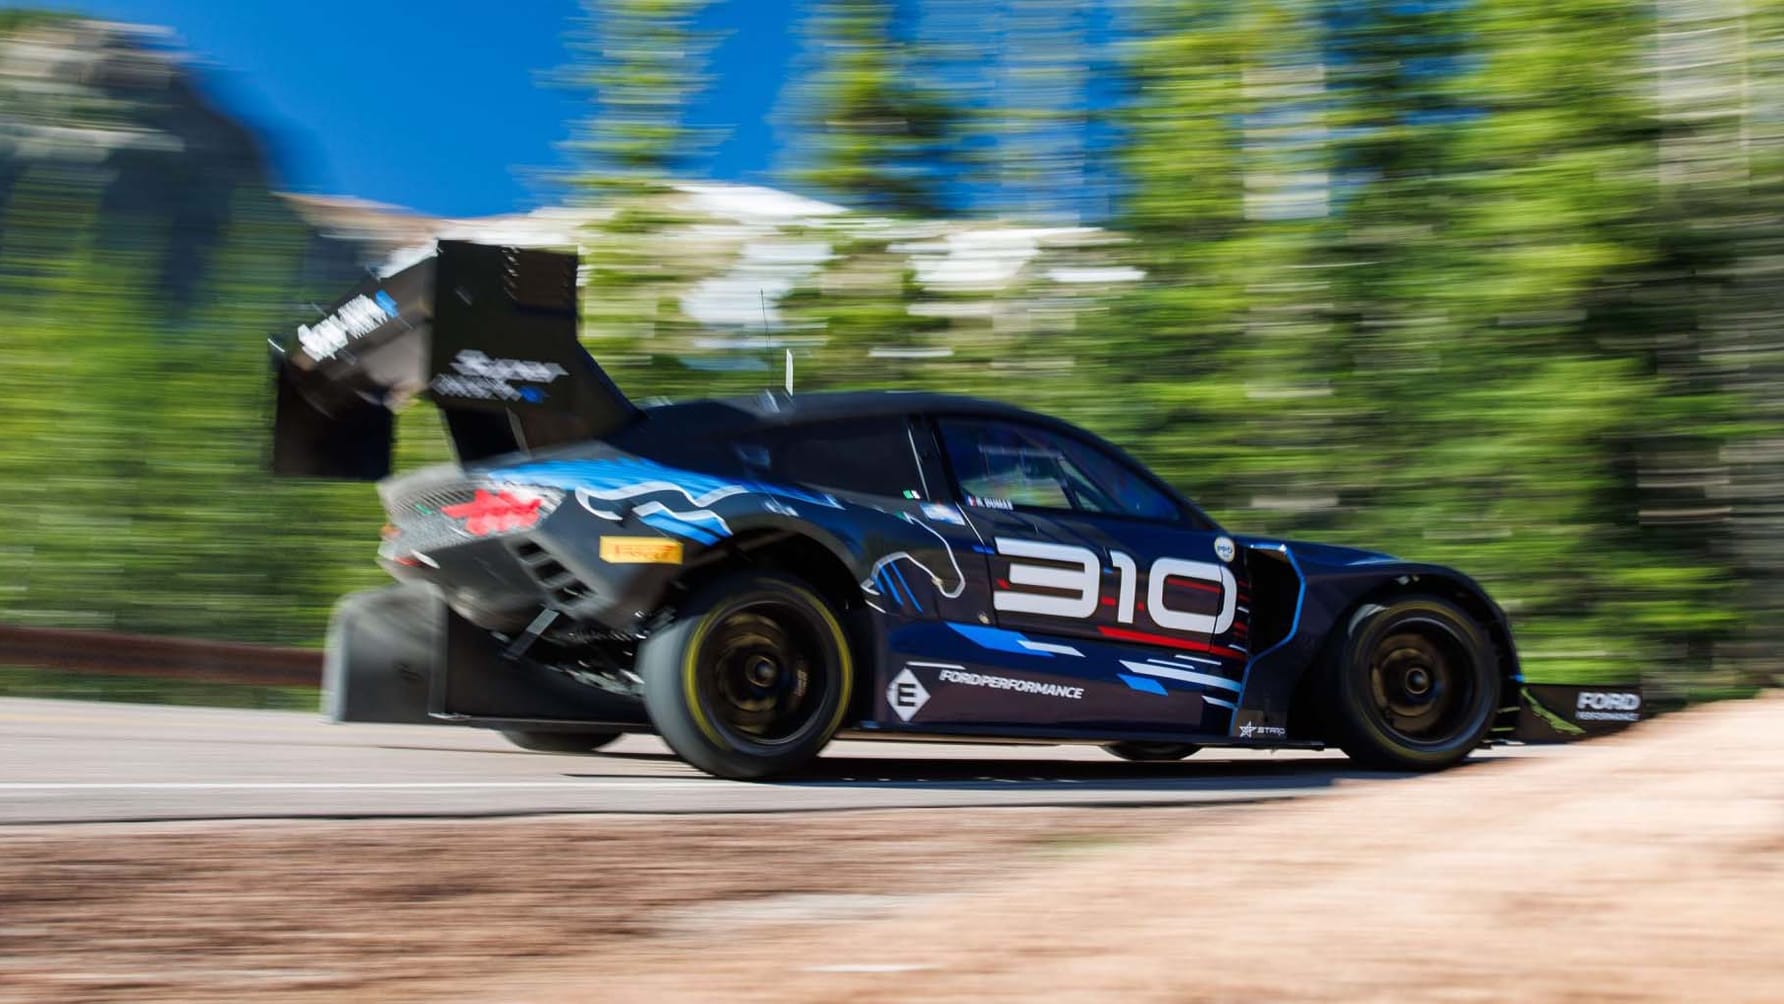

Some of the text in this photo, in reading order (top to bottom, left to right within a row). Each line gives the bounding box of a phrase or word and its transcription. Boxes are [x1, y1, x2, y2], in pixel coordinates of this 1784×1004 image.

[993, 537, 1238, 635] 310
[896, 683, 917, 707] E
[1576, 692, 1641, 710] FORD
